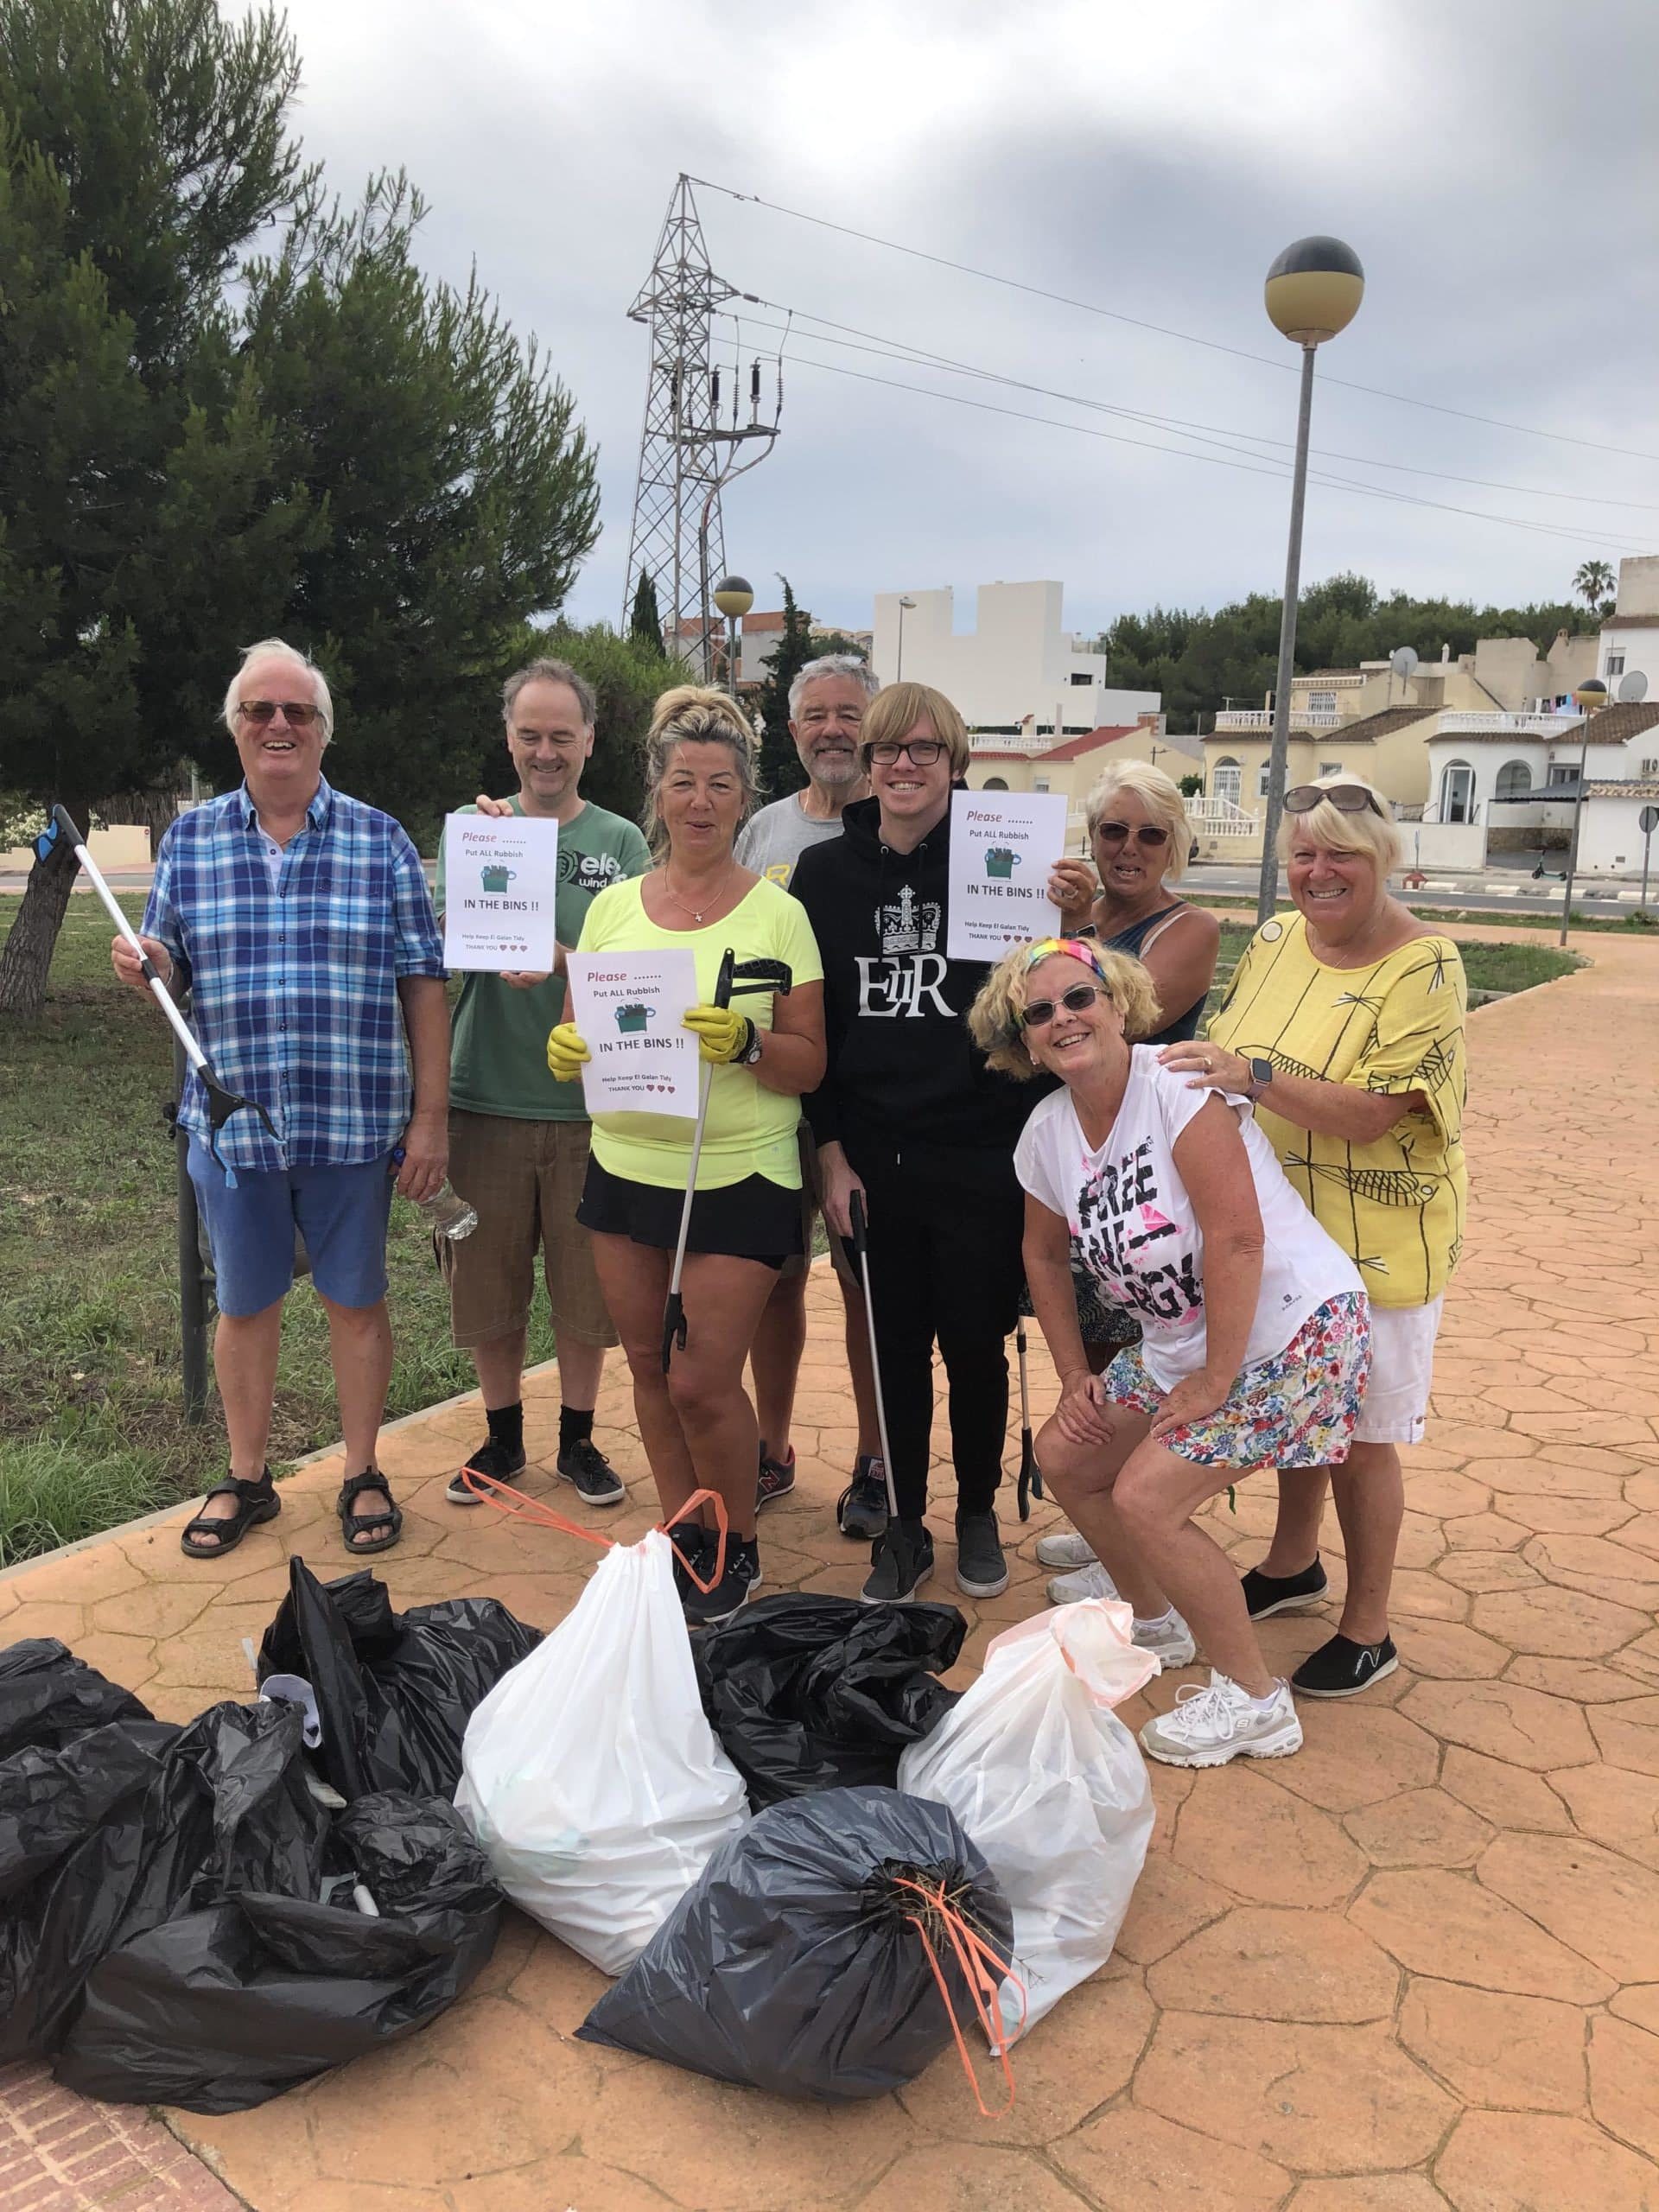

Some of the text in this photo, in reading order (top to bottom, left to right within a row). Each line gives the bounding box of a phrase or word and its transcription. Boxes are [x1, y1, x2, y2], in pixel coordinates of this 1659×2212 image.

[966, 810, 1002, 823] Please
[462, 832, 498, 842] Please
[969, 830, 982, 838] Put
[999, 831, 1029, 840] Rubbish
[494, 849, 524, 858] Rubbish
[967, 884, 978, 894] IN
[982, 885, 1003, 897] THE
[1007, 887, 1033, 899] BINS
[464, 899, 475, 909] IN
[479, 899, 499, 910] THE
[503, 900, 528, 911] BINS
[588, 972, 627, 982] Please
[626, 987, 660, 995] Rubbish
[600, 1043, 613, 1052] IN
[616, 1040, 640, 1051] THE
[644, 1039, 672, 1049] BINS
